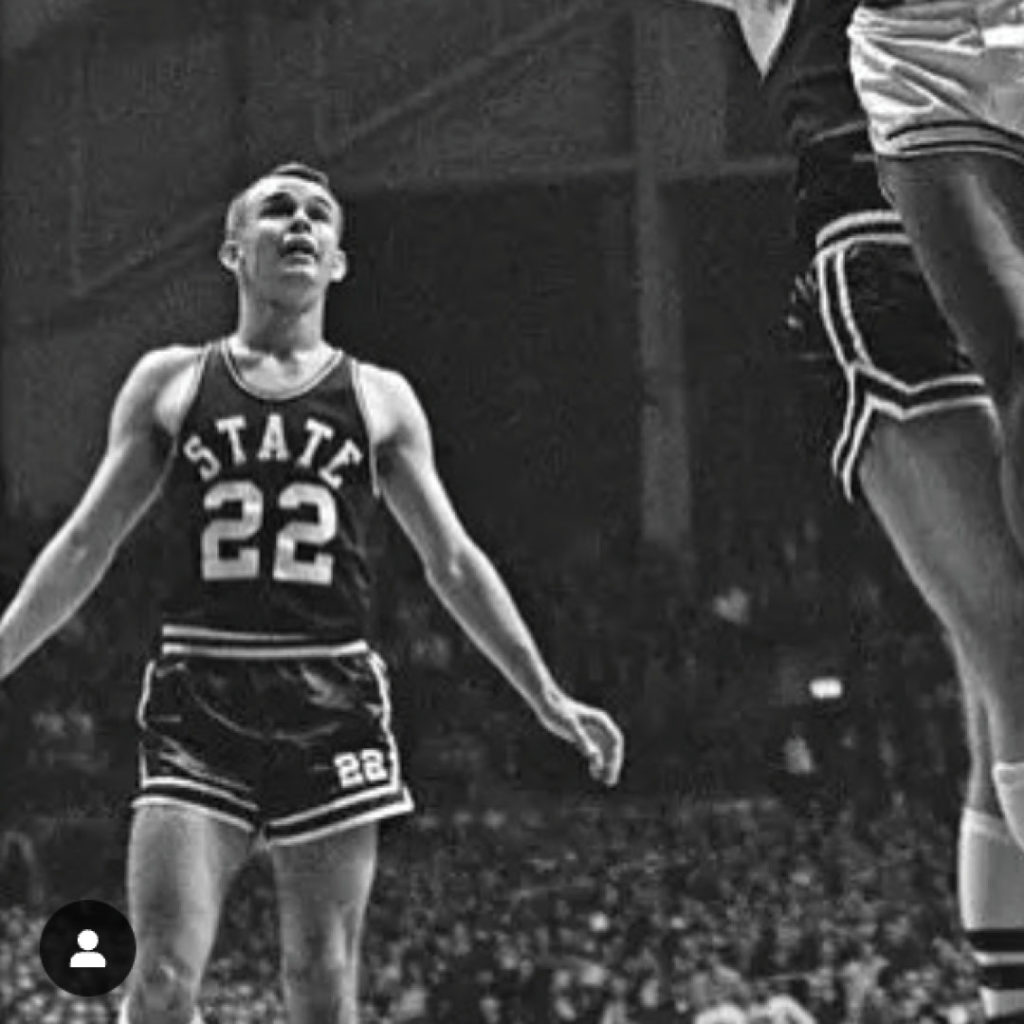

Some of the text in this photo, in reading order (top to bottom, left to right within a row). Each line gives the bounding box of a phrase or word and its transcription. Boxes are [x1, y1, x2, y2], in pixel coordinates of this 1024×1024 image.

[182, 413, 363, 490] STATE
[202, 480, 338, 586] 22
[333, 749, 388, 788] 22
